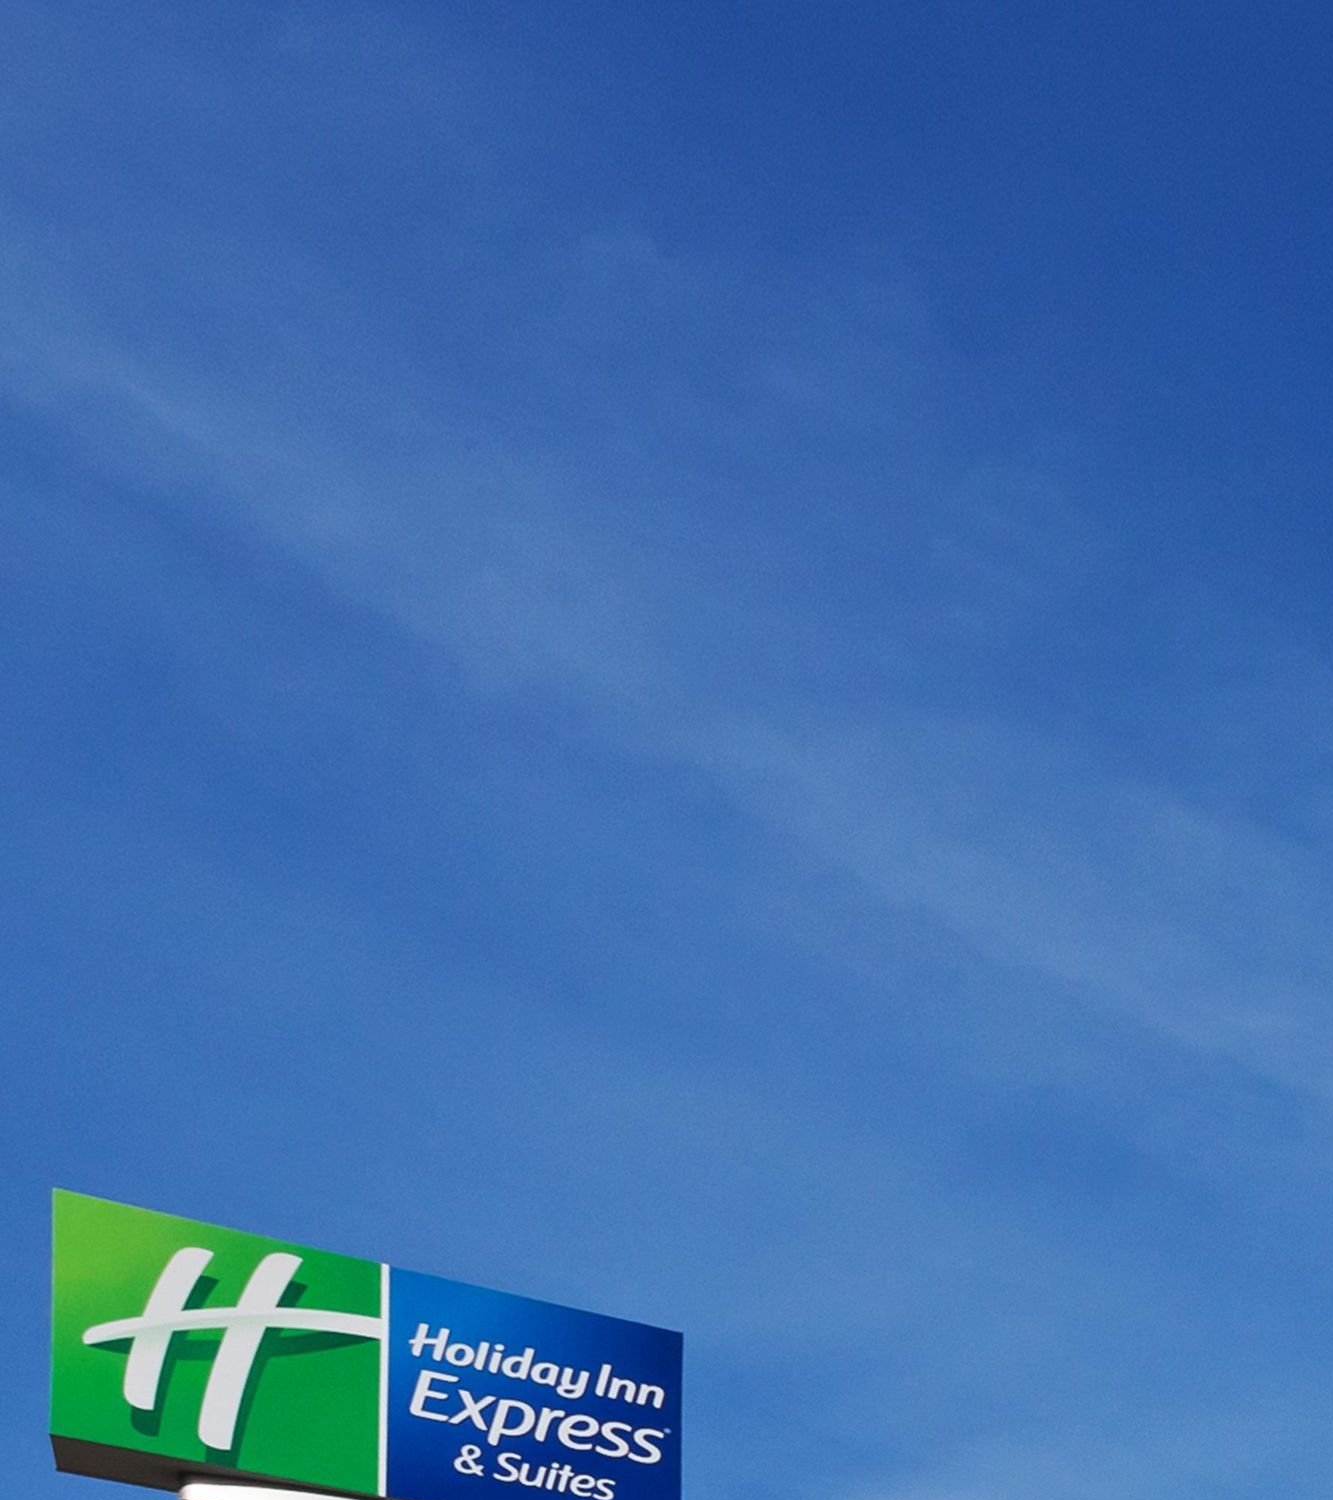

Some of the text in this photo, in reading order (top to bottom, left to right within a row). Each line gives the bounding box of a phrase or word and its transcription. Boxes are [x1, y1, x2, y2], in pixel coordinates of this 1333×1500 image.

[408, 1323, 665, 1409] Holiday Inn
[409, 1369, 665, 1464] Express
[453, 1444, 484, 1477] &
